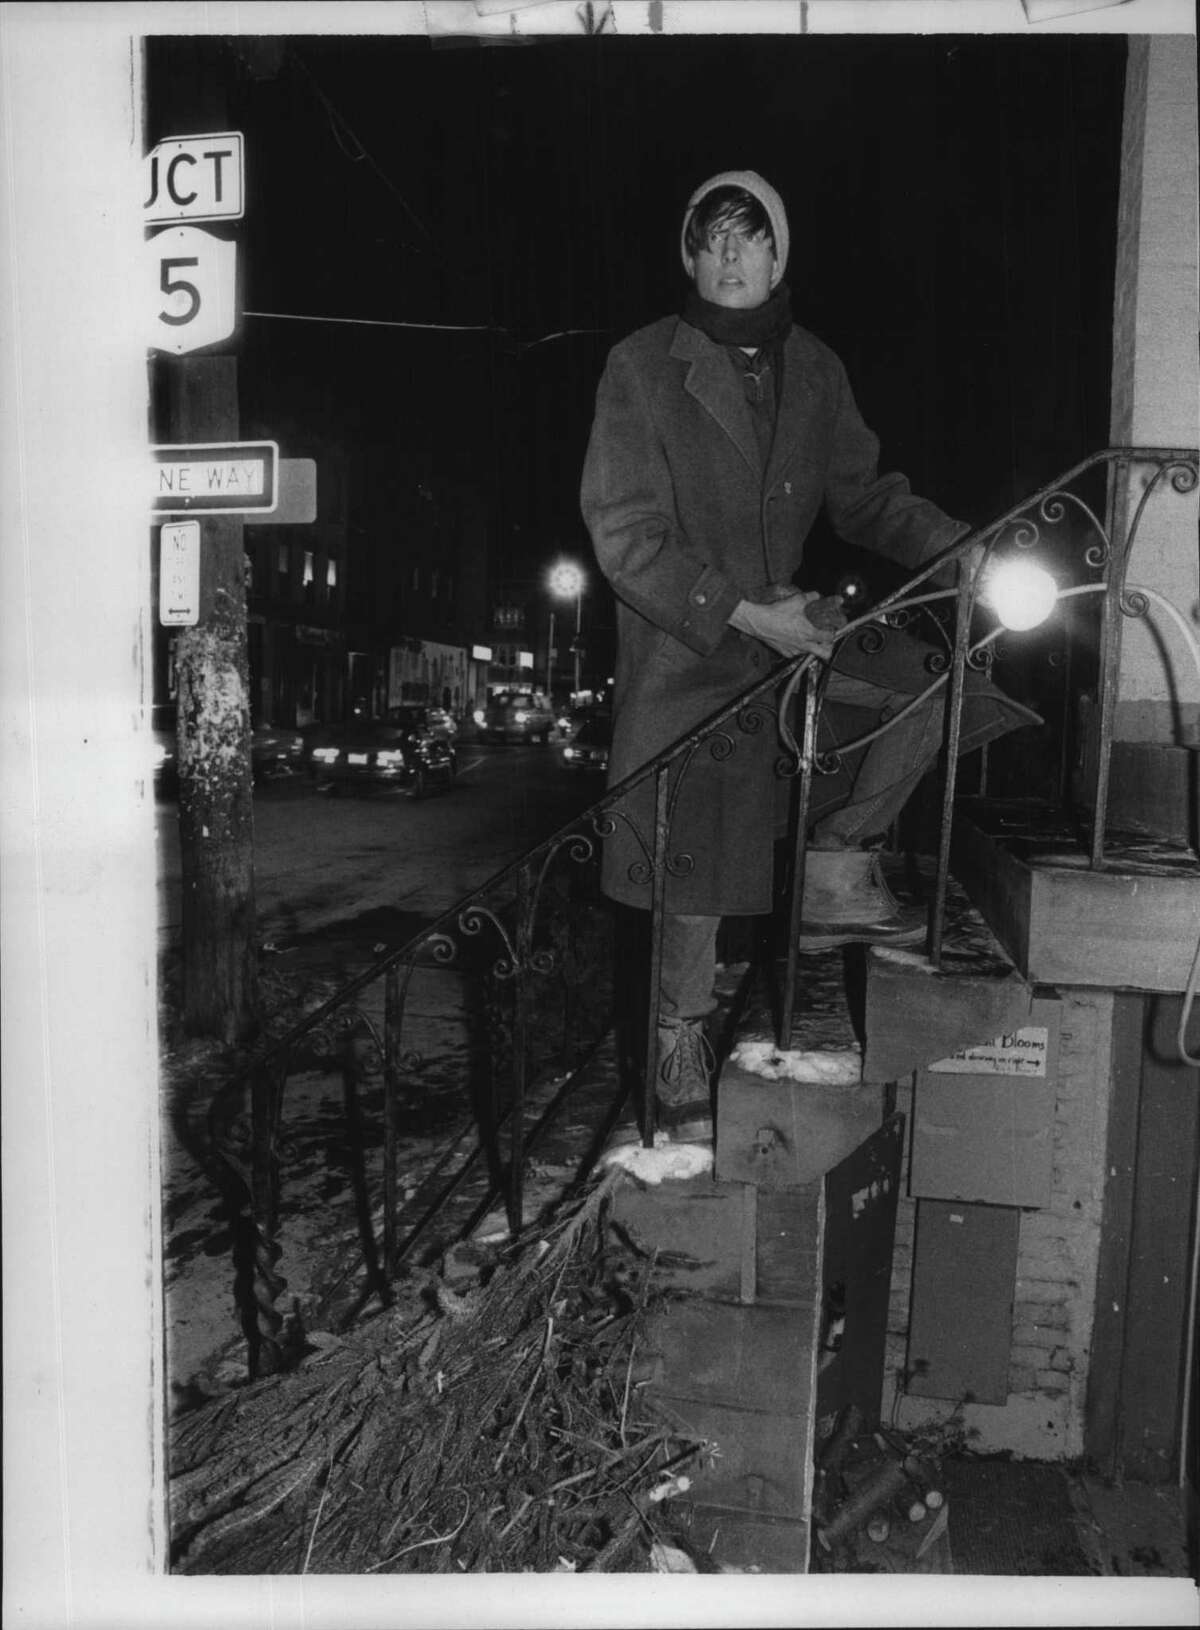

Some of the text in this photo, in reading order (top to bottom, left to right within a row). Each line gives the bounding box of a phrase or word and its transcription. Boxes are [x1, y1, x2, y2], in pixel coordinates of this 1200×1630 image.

[144, 151, 232, 209] JCT
[158, 257, 201, 326] 5
[158, 467, 256, 491] NE WAY
